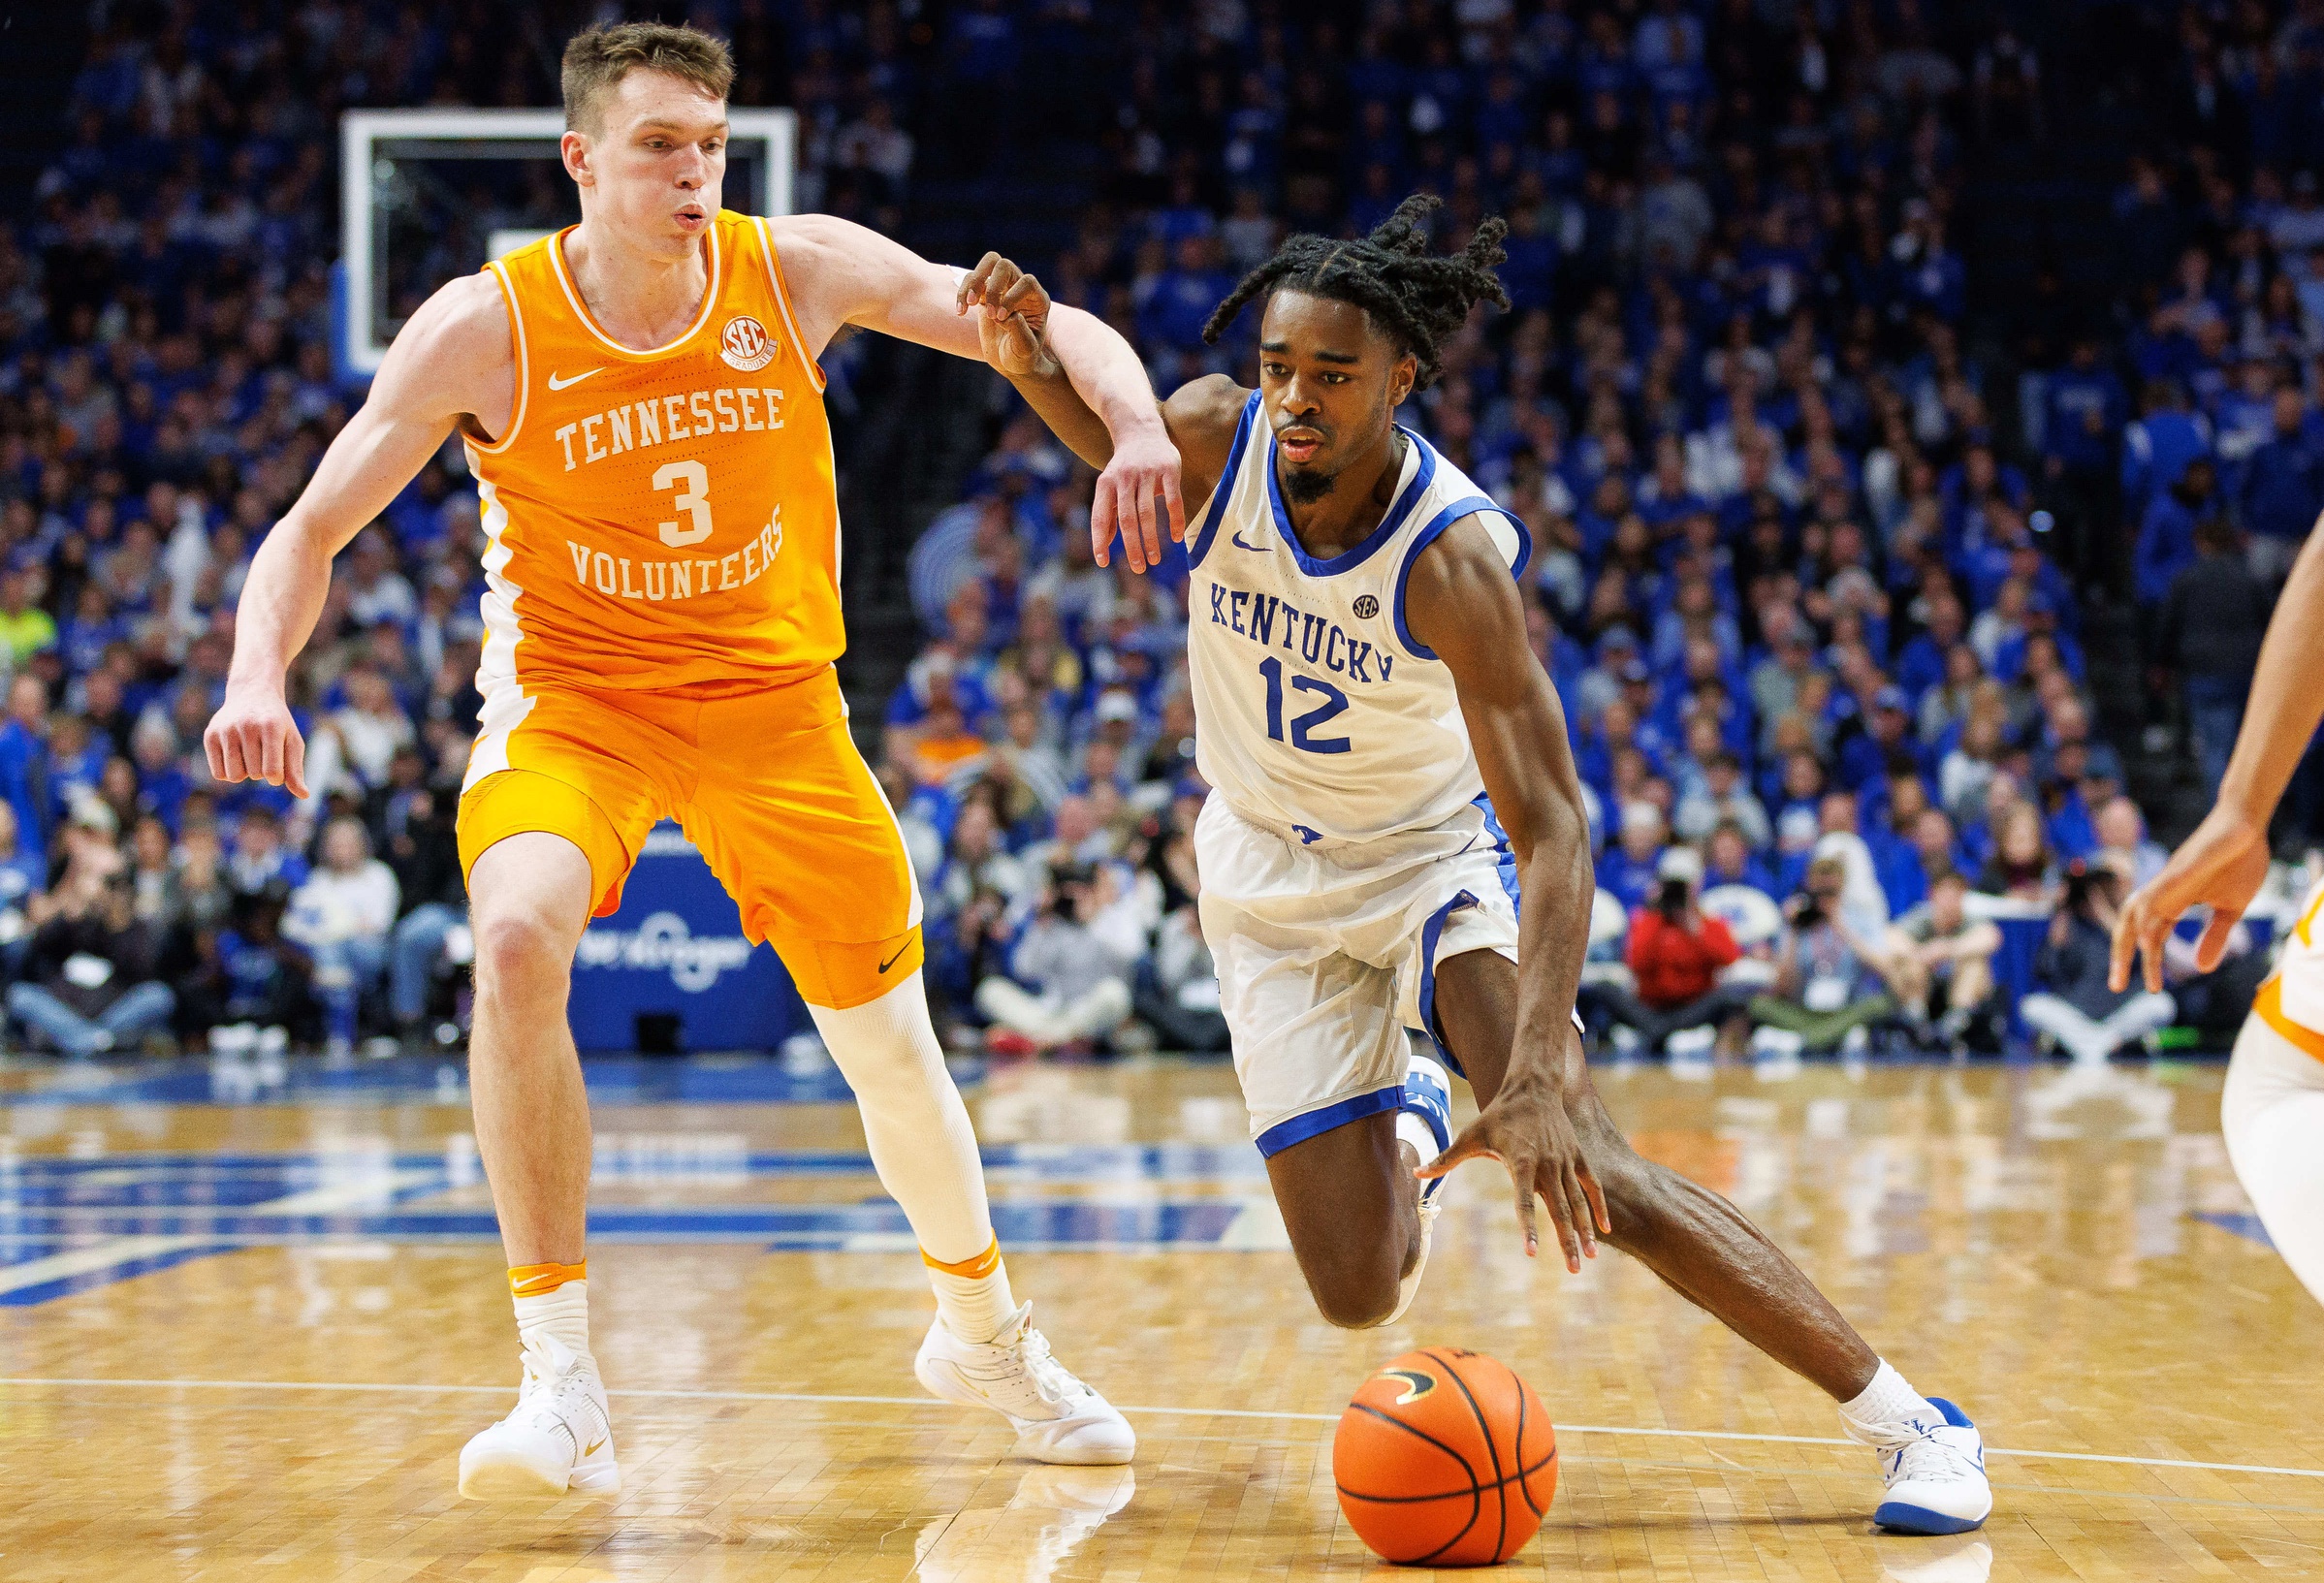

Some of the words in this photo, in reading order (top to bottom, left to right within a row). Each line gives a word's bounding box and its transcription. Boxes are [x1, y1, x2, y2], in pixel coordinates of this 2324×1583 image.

[726, 319, 765, 358] SEC
[729, 350, 774, 370] GRADUATE
[556, 388, 784, 472] TENNESSEE
[652, 459, 714, 549] 3
[566, 503, 783, 601] VOLUNTEERS
[1211, 583, 1393, 682] KENTUCKY
[1353, 596, 1378, 617] SEC
[1259, 655, 1352, 754] 12
